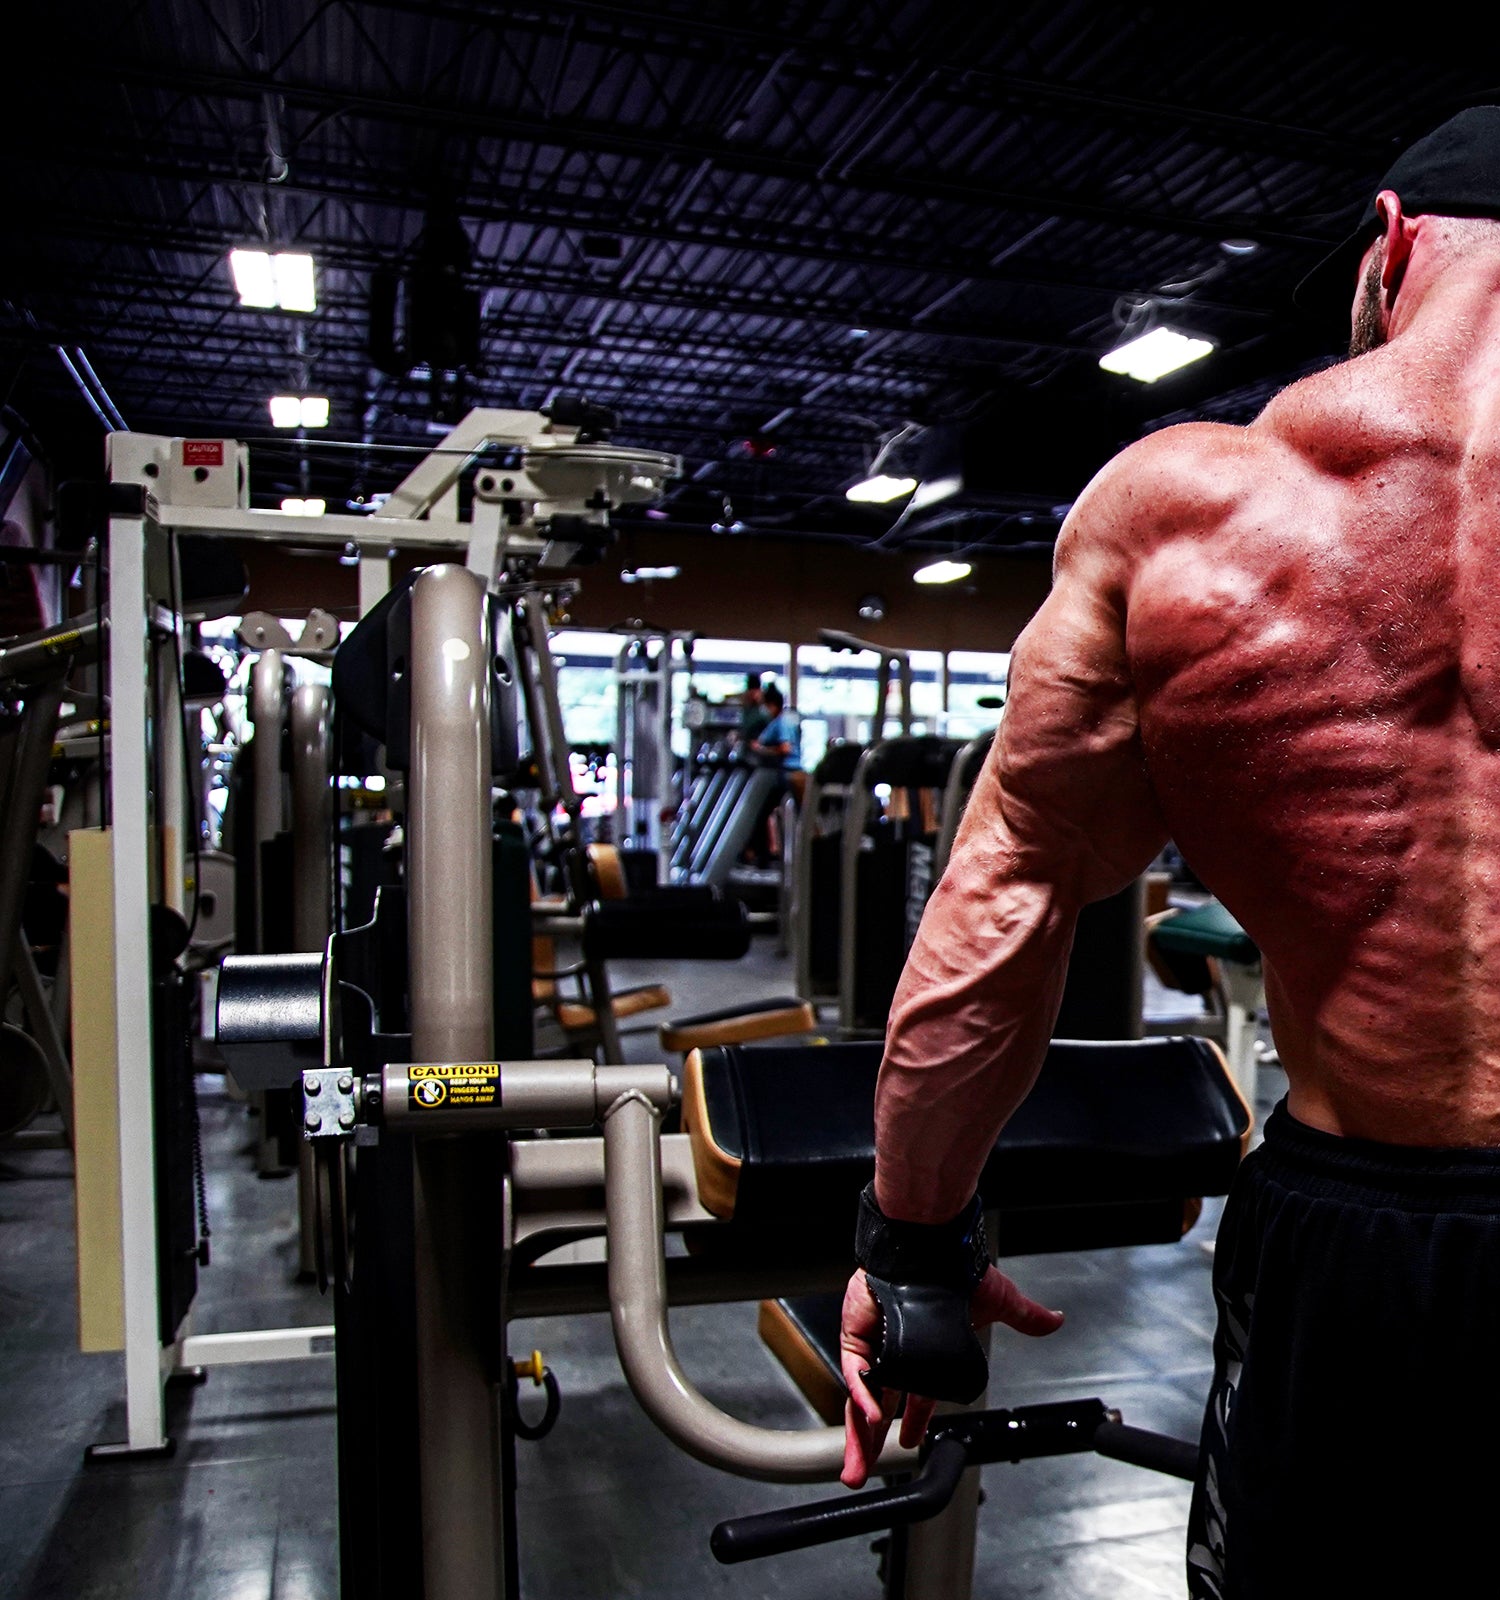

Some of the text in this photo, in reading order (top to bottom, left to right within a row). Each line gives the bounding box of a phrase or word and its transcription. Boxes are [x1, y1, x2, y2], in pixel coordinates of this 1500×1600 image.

[413, 1066, 495, 1076] CAUTION!
[450, 1085, 496, 1094] FINGERS AND
[450, 1095, 495, 1104] HANDS AWAY
